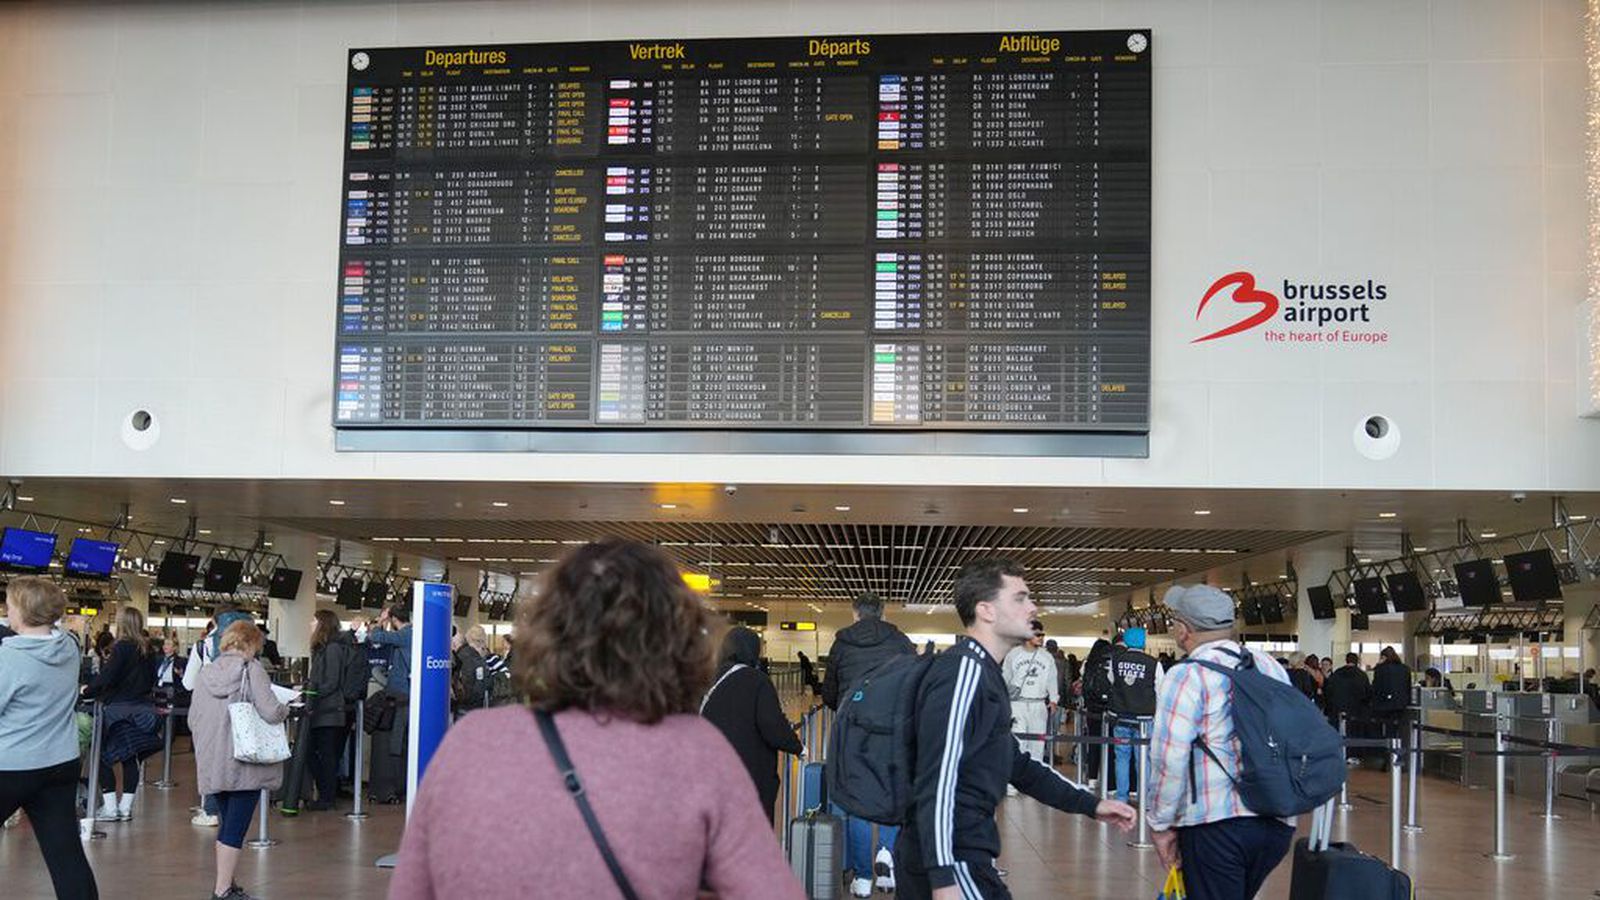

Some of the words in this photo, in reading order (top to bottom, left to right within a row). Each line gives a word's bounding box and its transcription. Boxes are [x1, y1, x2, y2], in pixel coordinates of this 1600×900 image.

[629, 43, 685, 60] Vertrek
[809, 39, 871, 58] Départs
[999, 36, 1061, 55] Abflüge
[425, 49, 507, 68] Departures
[1284, 279, 1387, 300] brussels
[1284, 301, 1370, 327] airport
[1264, 330, 1285, 342] the
[1289, 330, 1322, 342] heart
[1326, 330, 1340, 342] of
[1342, 330, 1388, 344] Europe
[1118, 661, 1146, 672] GUCCI
